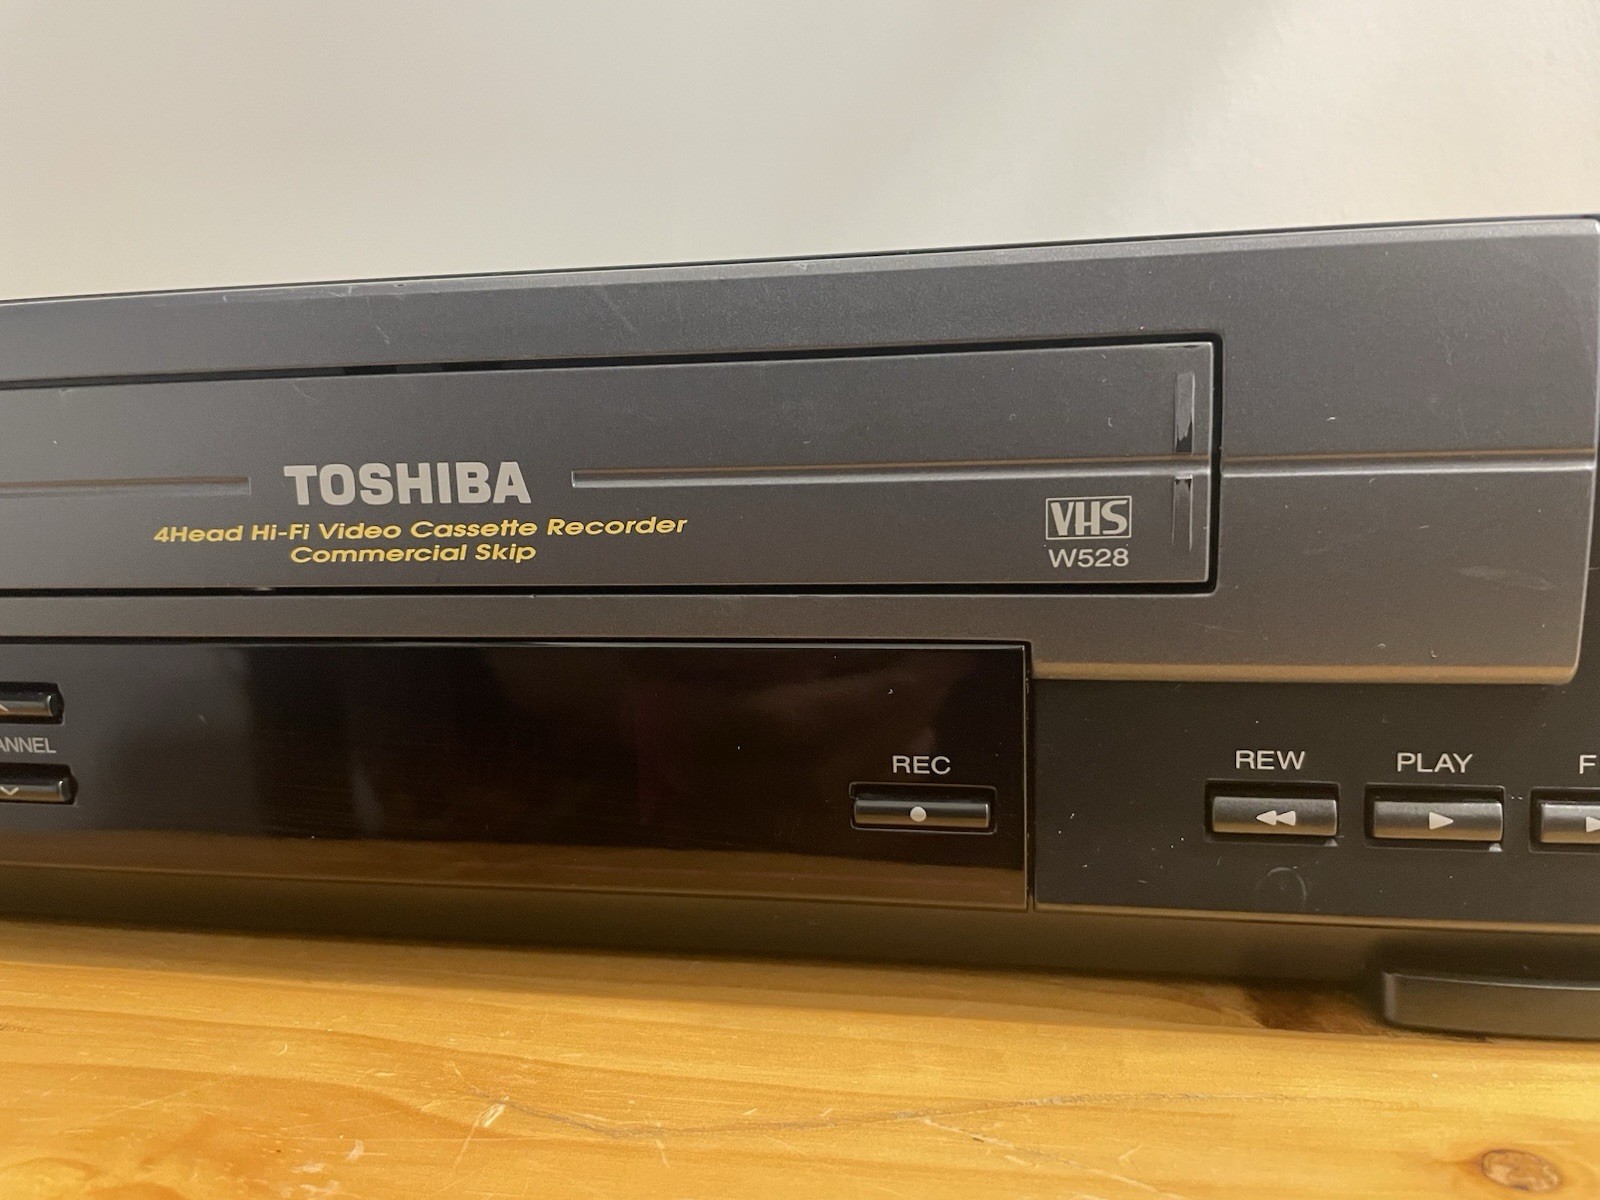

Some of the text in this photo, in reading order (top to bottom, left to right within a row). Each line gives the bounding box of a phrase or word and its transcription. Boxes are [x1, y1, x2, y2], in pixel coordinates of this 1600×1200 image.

[283, 461, 532, 506] TOSHIBA
[1050, 499, 1128, 536] VHS
[153, 516, 688, 543] 4Head Hi-Fi Video Cassette Recorder
[290, 543, 537, 564] Commercial Skip
[1048, 548, 1129, 568] W528
[892, 755, 951, 775] REC
[1235, 750, 1306, 770] REW
[1396, 752, 1474, 773] PLAY
